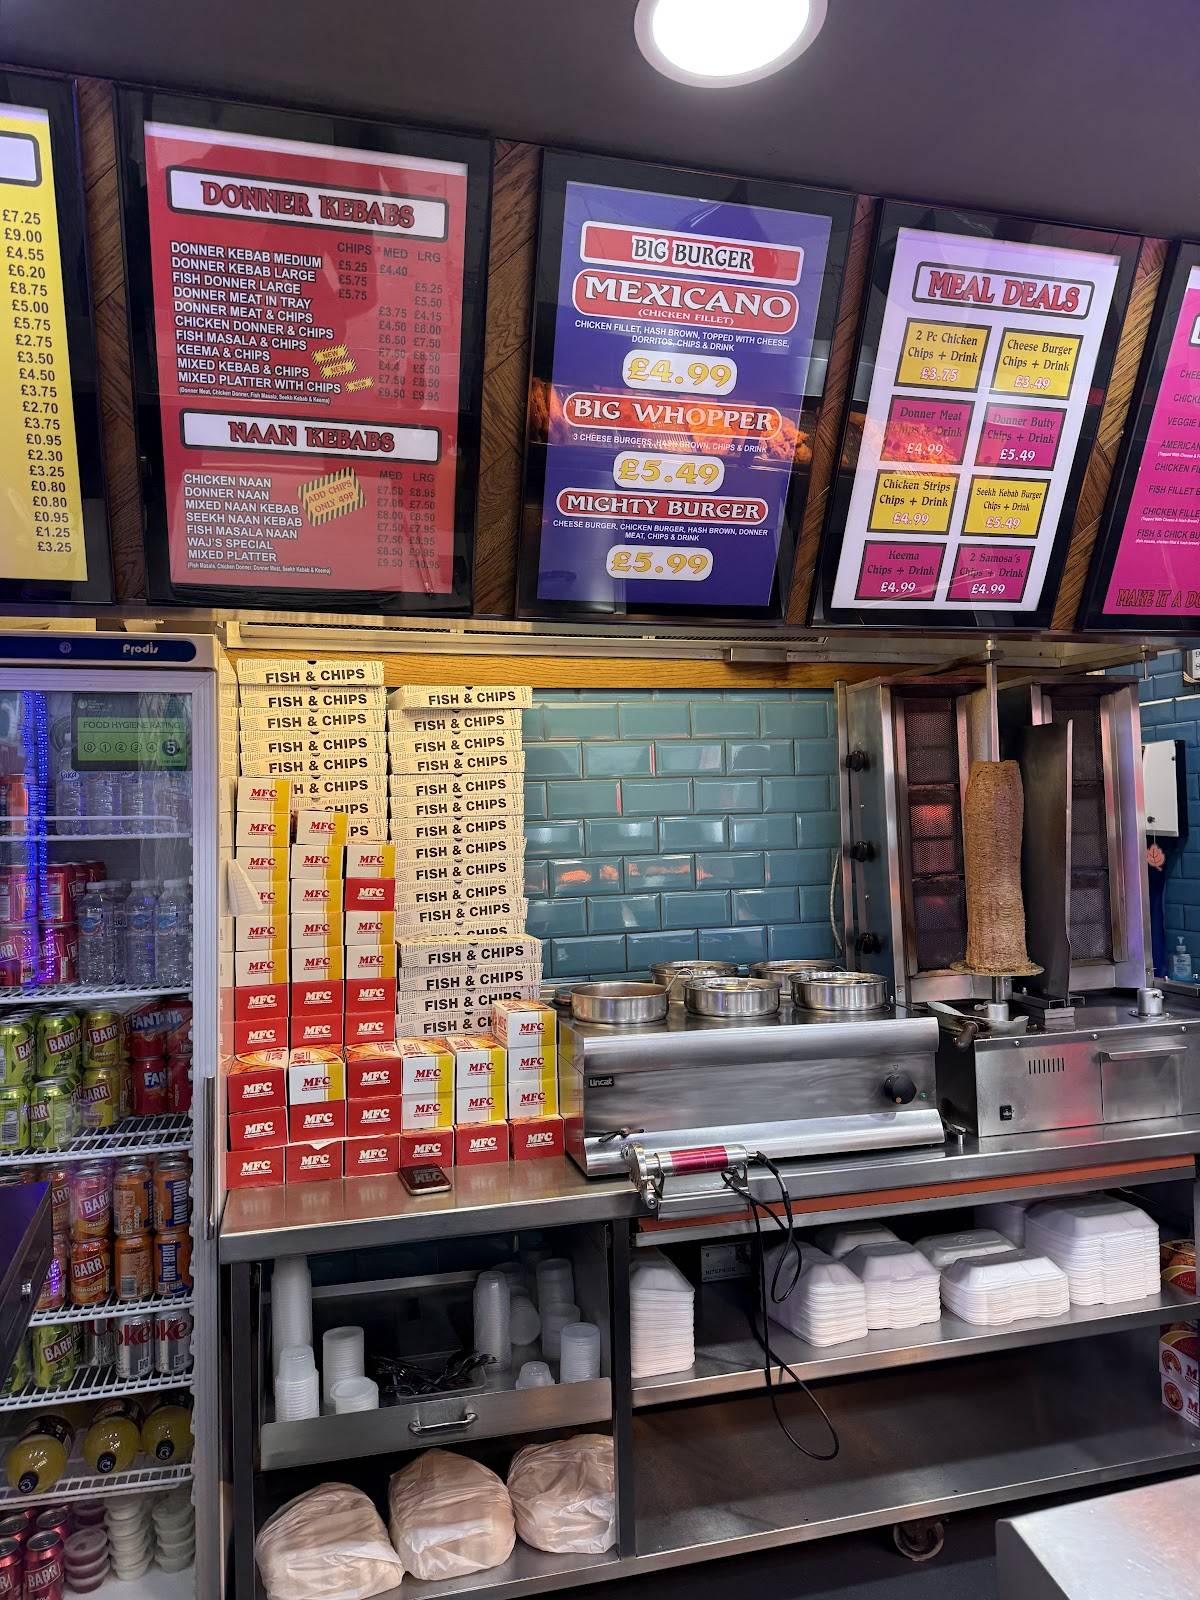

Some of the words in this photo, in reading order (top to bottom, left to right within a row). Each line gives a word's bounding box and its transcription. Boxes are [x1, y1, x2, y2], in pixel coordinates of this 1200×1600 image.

[200, 180, 312, 217] DONNER
[317, 194, 415, 228] KEBABS
[3, 209, 40, 225] £7.25
[5, 228, 42, 243] £9.00
[171, 241, 224, 257] DONNER
[227, 247, 270, 262] KEBAB
[273, 252, 321, 267] MEDIUM
[337, 242, 372, 255] CHIPS
[384, 247, 408, 259] MED
[634, 239, 668, 259] BIG
[674, 243, 752, 269] BURGER
[8, 264, 45, 279] £6.20
[172, 271, 200, 284] FISH
[204, 274, 256, 290] DONNER
[259, 280, 300, 294] LARGE
[173, 286, 226, 301] DONNER
[229, 291, 262, 304] MEAT
[265, 294, 276, 306] IN
[279, 296, 311, 309] TRAY
[584, 275, 791, 317] MEXICANO
[928, 270, 994, 303] MEAL
[1003, 279, 1080, 312] DEALS
[638, 308, 690, 320] (CHICKEN
[694, 313, 734, 326] FILLET)
[175, 315, 229, 329] CHICKEN
[233, 320, 284, 334] DONNER
[286, 325, 295, 335] &
[298, 326, 333, 339] CHIPS
[574, 319, 612, 330] CHICKEN
[613, 323, 641, 334] FILLET,
[643, 326, 666, 335] HASH
[667, 328, 700, 339] BROWN,
[702, 331, 733, 341] TOPPED
[735, 334, 755, 344] WITH
[756, 336, 789, 347] CHEESE,
[632, 335, 675, 347] DORRITOS,
[677, 340, 700, 348] CHIPS
[709, 342, 734, 352] DRINK
[915, 329, 922, 340] 2
[926, 330, 937, 341] Pc
[941, 332, 977, 345] Chicken
[176, 343, 220, 357] KEEMA
[222, 347, 231, 357] &
[234, 348, 269, 361] CHIPS
[907, 346, 933, 360] Chips
[938, 351, 946, 360] +
[950, 350, 977, 362] Drink
[1007, 339, 1038, 351] Cheese
[1041, 342, 1072, 356] Burger
[17, 351, 53, 364] £3.50
[626, 357, 731, 388] £4.99
[920, 367, 959, 382] £3.75
[178, 371, 215, 383] MIXED
[219, 374, 271, 388] PLATTER
[273, 378, 303, 390] WITH
[306, 381, 340, 393] CHIPS
[1014, 375, 1050, 390] £3.49
[573, 399, 620, 420] BIG
[633, 403, 774, 432] WHOPPER
[899, 406, 936, 419] Donner
[939, 409, 961, 421] Meat
[1168, 416, 1197, 427] VEGGIE
[227, 421, 297, 446] NAAN
[304, 426, 395, 452] KEBABS
[28, 450, 62, 461] £2.30
[1000, 448, 1034, 462] £5.49
[619, 458, 720, 485] £5.49
[1154, 463, 1189, 472] CHICKEN
[183, 473, 235, 485] CHICKEN
[239, 476, 271, 487] NAAN
[883, 478, 919, 489] Chicken
[922, 480, 950, 493] Strips
[308, 491, 326, 503] ADD
[328, 480, 352, 497] CHIPS
[976, 487, 996, 496] Seekh
[998, 488, 1018, 497] Kebab
[1020, 489, 1042, 500] Burger
[1148, 485, 1166, 493] FISH
[1169, 486, 1194, 495] FILLET
[314, 499, 335, 512] ONLY
[567, 494, 658, 514] MIGHTY
[667, 500, 760, 520] BURGER
[1142, 507, 1177, 516] CHICKEN
[36, 527, 70, 538] £1.25
[186, 524, 212, 534] FISH
[215, 525, 263, 537] MASALA
[265, 528, 297, 538] NAAN
[552, 519, 583, 527] CHEESE
[584, 521, 618, 530] BURGER,
[619, 523, 652, 531] CHICKEN
[653, 524, 685, 533] BURGER,
[708, 527, 737, 535] BROWN,
[187, 536, 222, 547] WAJ'S
[225, 538, 273, 549] SPECIAL
[624, 532, 645, 540] MEAT,
[647, 532, 669, 540] CHIPS
[611, 552, 708, 574] £5.99
[888, 550, 920, 561] Keema
[969, 552, 975, 561] 2
[978, 552, 1020, 563] Samosa's
[880, 581, 916, 593] £4.99
[971, 583, 1005, 595] £4.99
[1116, 589, 1154, 607] MAKE
[123, 641, 158, 655] Prodis
[265, 671, 300, 684] FISH
[305, 670, 316, 681] &
[320, 668, 365, 680] CHIPS
[428, 693, 458, 705] FISH
[463, 693, 472, 703] &
[476, 690, 515, 702] CHIPS
[83, 721, 109, 729] FOOD
[112, 721, 148, 729] HYGIENE
[167, 741, 175, 754] 5
[268, 741, 302, 752] FISH
[308, 740, 318, 751] &
[323, 737, 367, 750] CHIPS
[251, 788, 277, 798] MFC
[249, 858, 276, 866] MFC
[415, 867, 447, 880] FISH
[452, 866, 461, 876] &
[465, 862, 506, 875] CHIPS
[358, 887, 384, 896] MFC
[428, 951, 461, 964] FISH
[466, 949, 476, 960] &
[480, 945, 523, 959] CHIPS
[248, 961, 275, 970] MFC
[520, 1022, 544, 1031] MFC
[468, 1062, 494, 1072] MFC
[304, 1076, 331, 1087] MFC
[590, 1078, 612, 1086] Lincat
[527, 1132, 553, 1143] MFC
[242, 1161, 271, 1172] MFC
[74, 1258, 102, 1278] BARR
